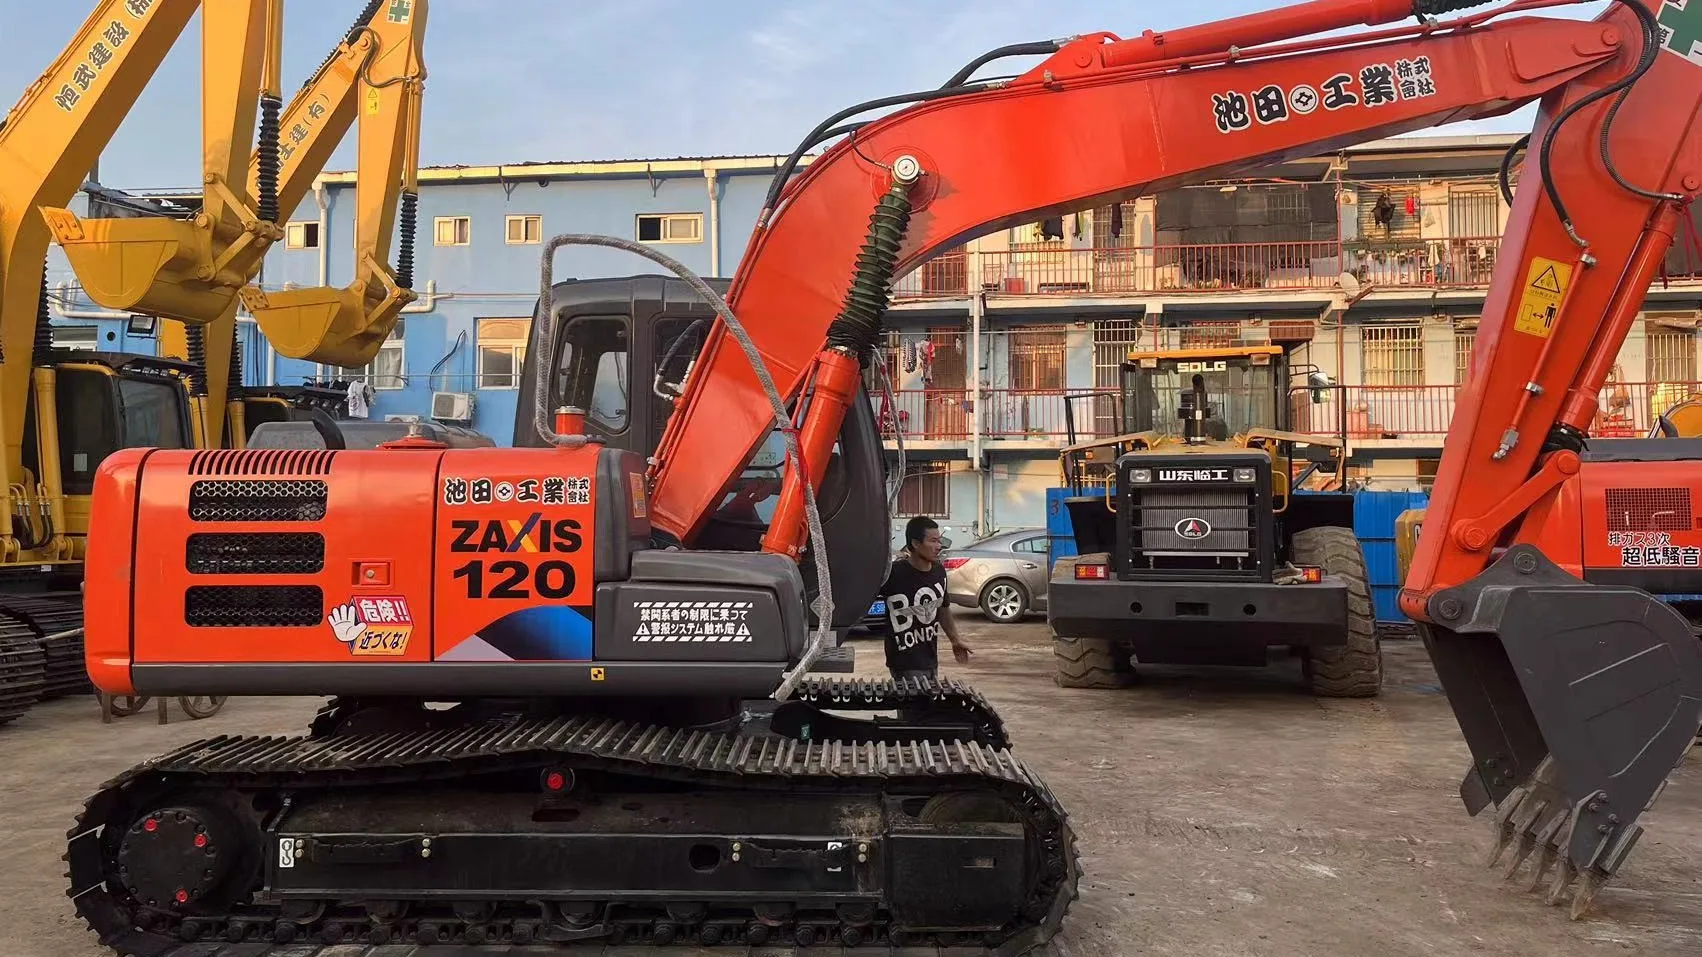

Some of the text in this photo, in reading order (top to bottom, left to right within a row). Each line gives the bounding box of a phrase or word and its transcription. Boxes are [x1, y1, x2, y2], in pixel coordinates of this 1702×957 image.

[1177, 361, 1226, 372] SDLG
[1159, 469, 1229, 481] 山东临工
[451, 512, 582, 553] ZAXIS
[1608, 531, 1671, 546] 排ガス3次
[453, 560, 576, 599] 120
